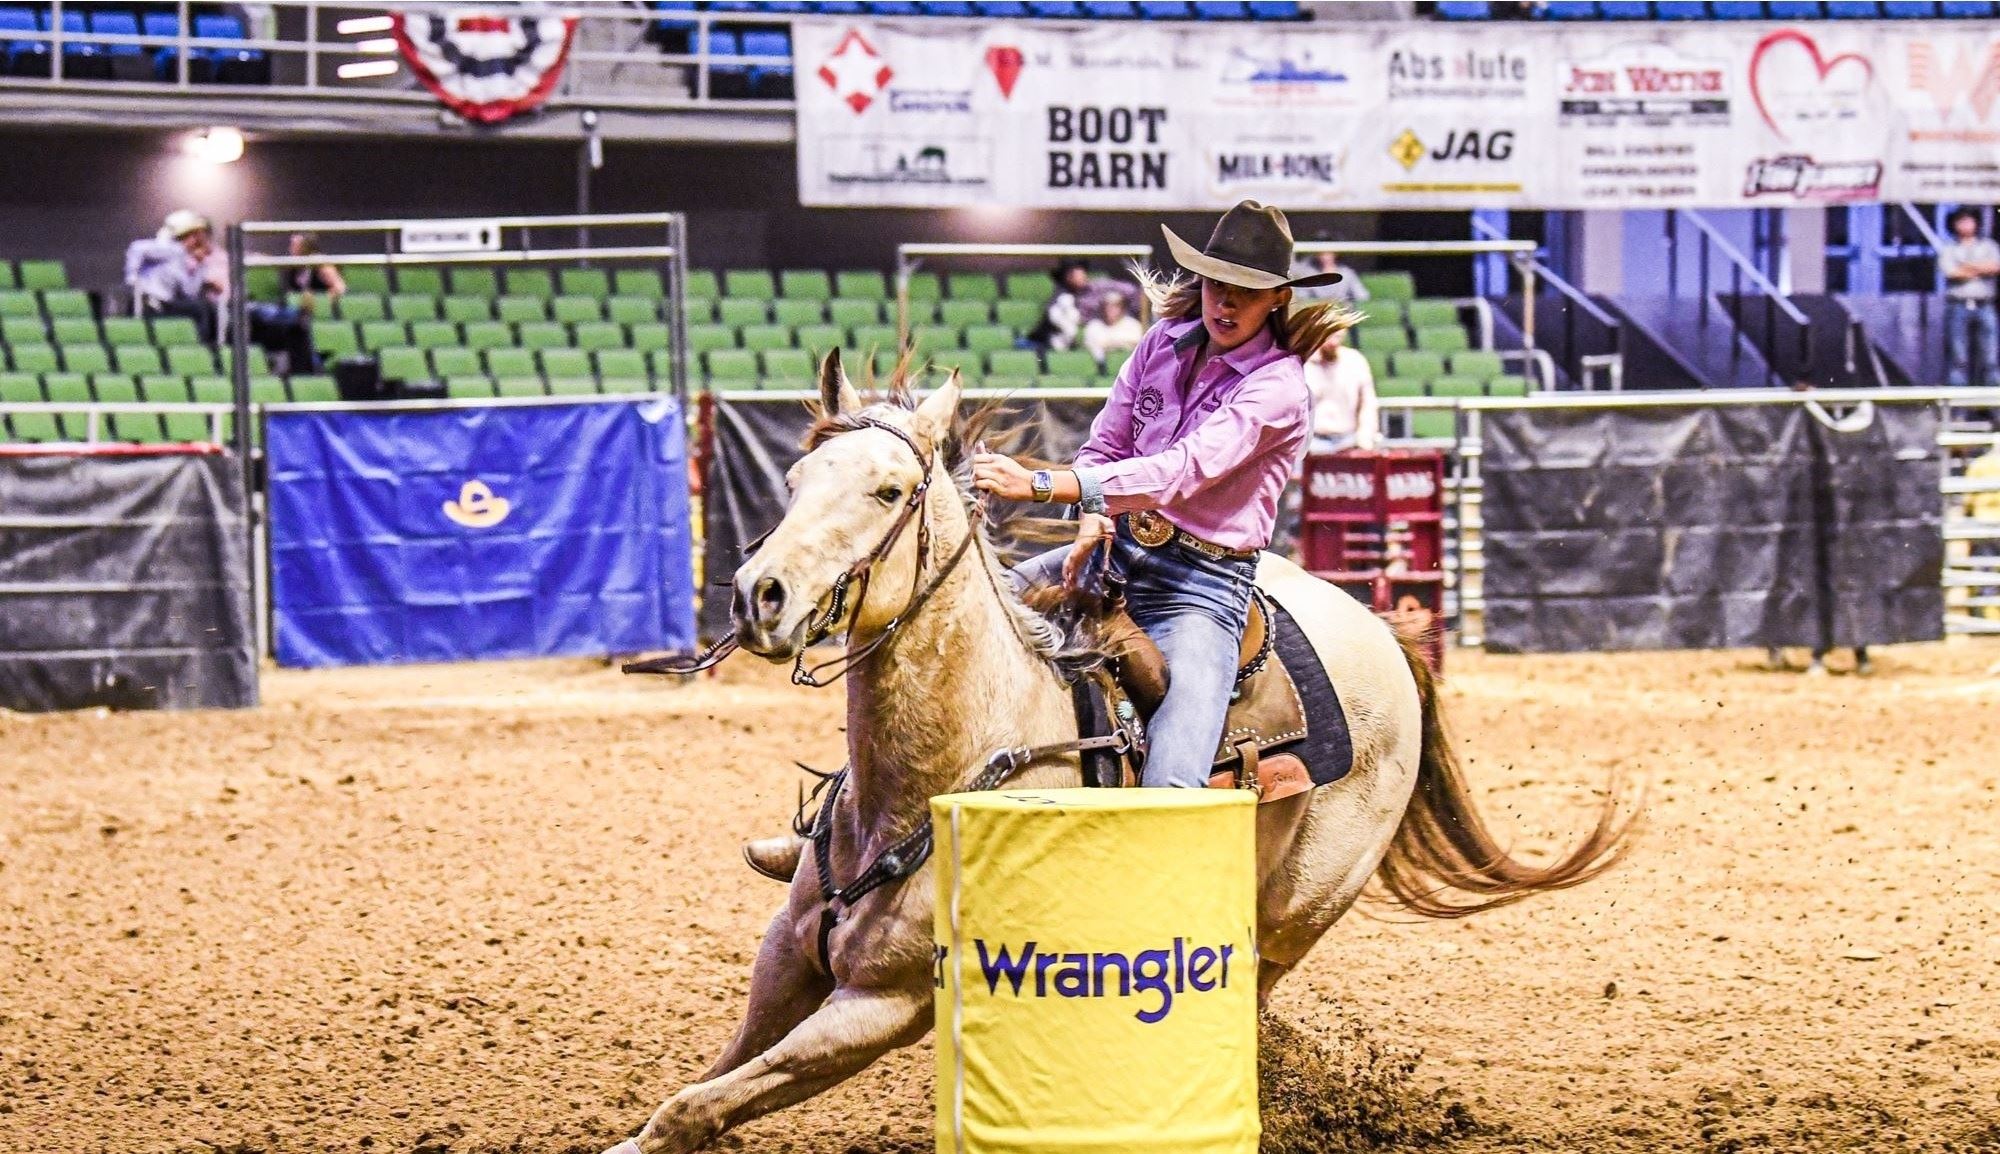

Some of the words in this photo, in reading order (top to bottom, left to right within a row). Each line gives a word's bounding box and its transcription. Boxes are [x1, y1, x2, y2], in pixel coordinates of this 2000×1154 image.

[1047, 106, 1167, 143] BOOT
[1431, 129, 1516, 161] JAG
[1047, 151, 1167, 188] BARN
[973, 936, 1234, 1024] Wrangler
